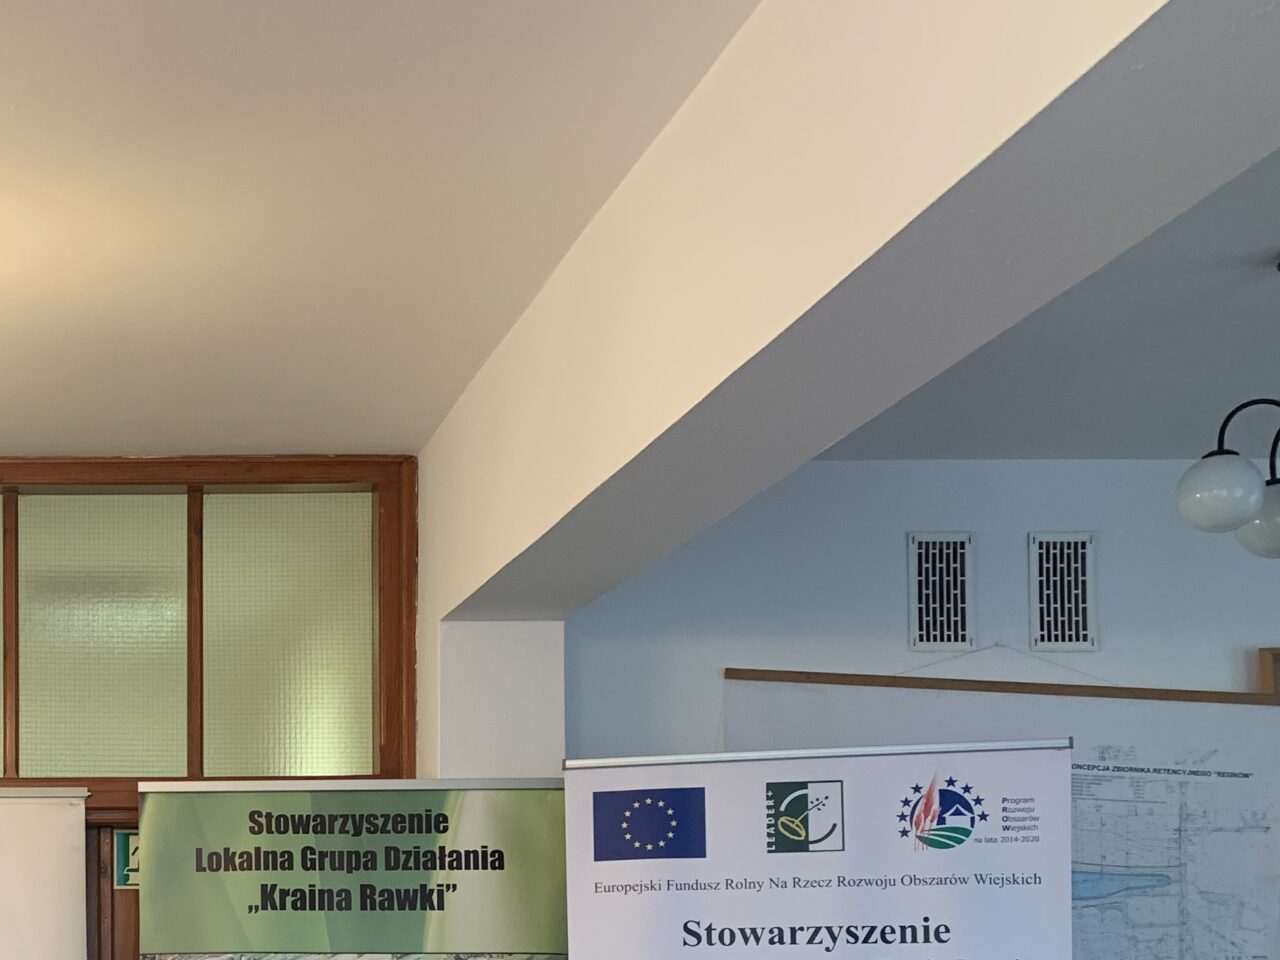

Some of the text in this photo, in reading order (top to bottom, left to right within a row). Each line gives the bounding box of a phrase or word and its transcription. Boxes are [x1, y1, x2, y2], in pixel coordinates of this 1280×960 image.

[1071, 763, 1111, 773] ONCEPCJA
[1001, 797, 1035, 805] Program
[1001, 806, 1035, 814] Rozwoju
[248, 809, 449, 837] Stowarzyszenie
[767, 790, 776, 851] LEADER+
[1001, 815, 1040, 823] Obszarów
[1001, 824, 1039, 832] Wiejskich
[1000, 835, 1040, 843] 2014-2020
[195, 845, 505, 875] Lokalna Grupa Działania
[594, 872, 1042, 895] Europejski Fundusz Rolny Na Rzecz Rozwoju Obszarów Wiejskich
[248, 883, 457, 915] „Kraina Rawki”
[682, 917, 951, 952] Stowarzyszenie
